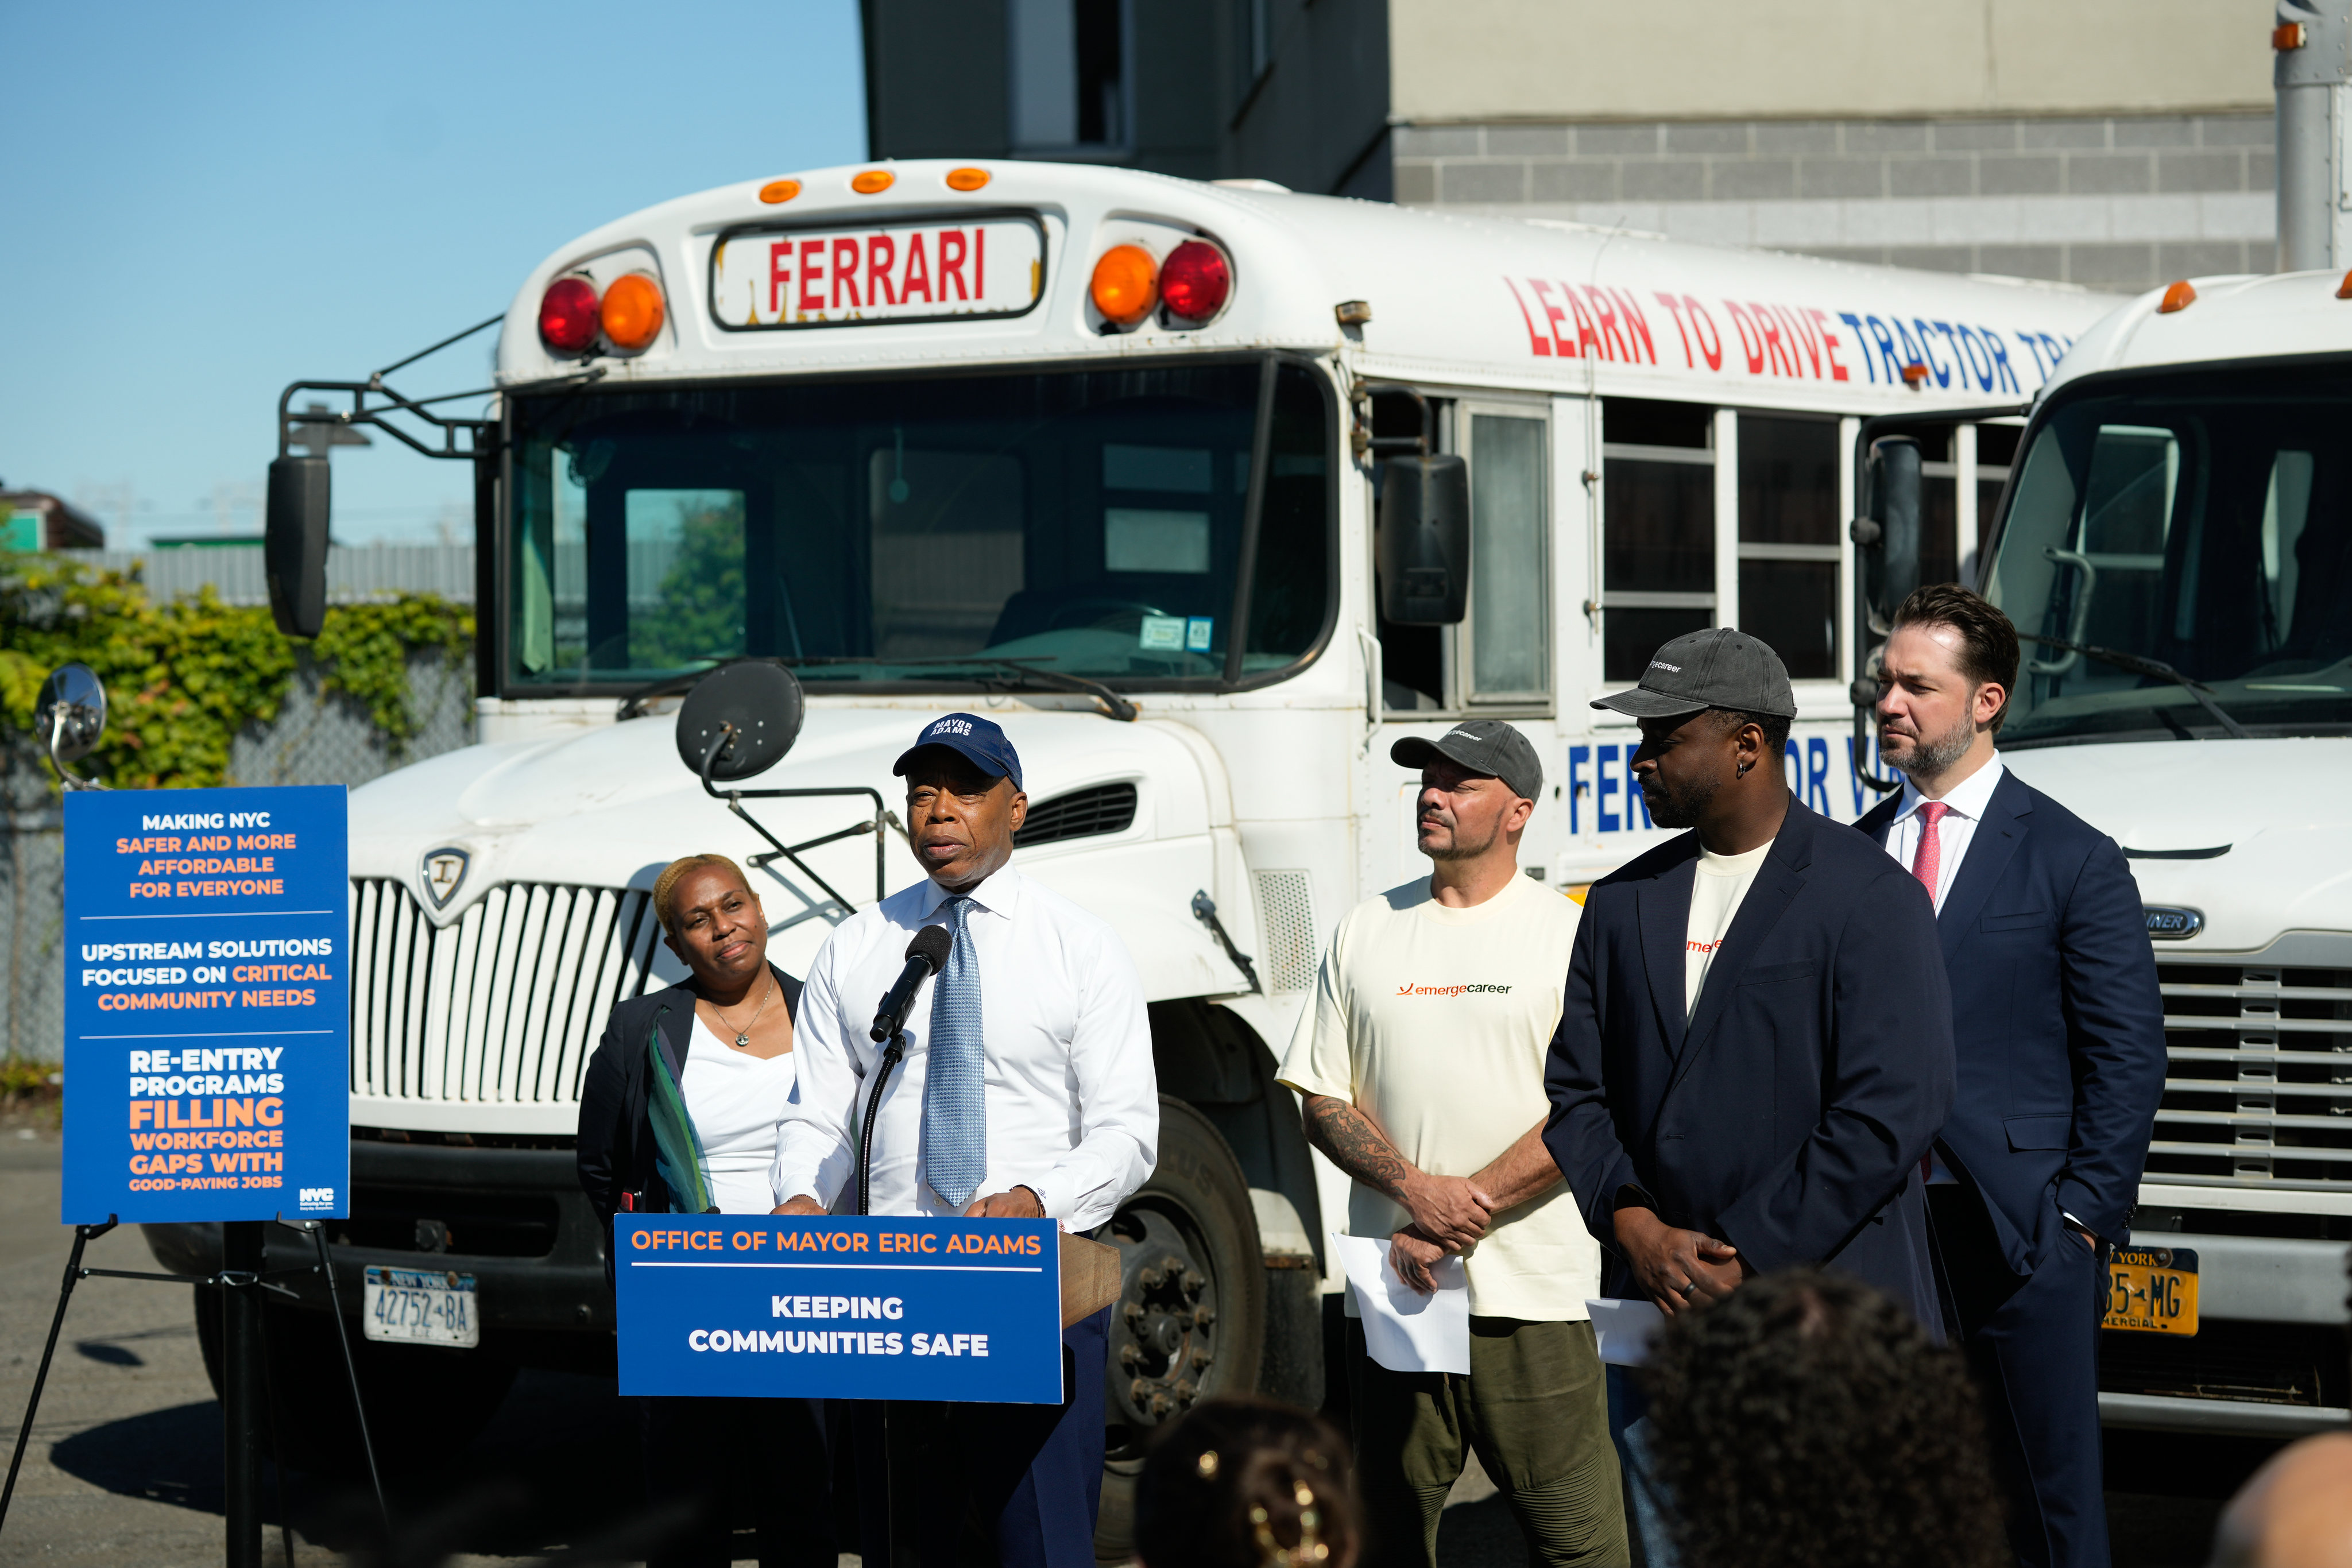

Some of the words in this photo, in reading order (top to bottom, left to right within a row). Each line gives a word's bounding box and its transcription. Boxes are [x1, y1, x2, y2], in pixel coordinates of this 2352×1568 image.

[770, 227, 984, 313] FERRARI
[1503, 277, 1656, 365] LEARN
[1656, 293, 1723, 372] TO
[1723, 299, 1850, 382] DRIVE
[1839, 313, 2020, 395] TRACTOR
[2014, 331, 2072, 385] TR
[930, 726, 970, 736] ADAMS
[933, 719, 973, 730] MAYOR
[142, 813, 225, 831] MAKING
[229, 811, 270, 828] NYC
[116, 837, 182, 854] SAFER
[186, 835, 232, 852] AND
[237, 834, 296, 851] MORE
[138, 857, 274, 876] AFFORDABLE
[130, 882, 172, 899] FOR
[176, 878, 284, 897] EVERYONE
[82, 942, 203, 962] UPSTREAM
[208, 938, 332, 959] SOLUTIONS
[82, 967, 187, 986] FOCUSED
[192, 966, 226, 984] ON
[232, 963, 332, 983] CRITICAL
[98, 990, 236, 1011] COMMUNITY
[242, 989, 316, 1008] NEEDS
[1415, 984, 1512, 997] emergecareer
[130, 1047, 284, 1073] RE-ENTRY
[130, 1073, 284, 1097] PROGRAMS
[129, 1097, 284, 1130] FILLING
[130, 1129, 284, 1151] WORKFORCE
[129, 1153, 204, 1175] GAPS
[210, 1152, 283, 1173] WITH
[129, 1176, 239, 1192] GOOD-PAYING
[241, 1175, 283, 1189] JOBS
[300, 1188, 334, 1202] NYC
[631, 1230, 724, 1250] OFFICE
[732, 1231, 767, 1251] OF
[777, 1232, 869, 1252] MAYOR
[879, 1233, 937, 1253] ERIC
[945, 1234, 1041, 1255] ADAMS
[772, 1295, 903, 1320] KEEPING
[688, 1330, 904, 1356] COMMUNITIES
[911, 1333, 989, 1357] SAFE
